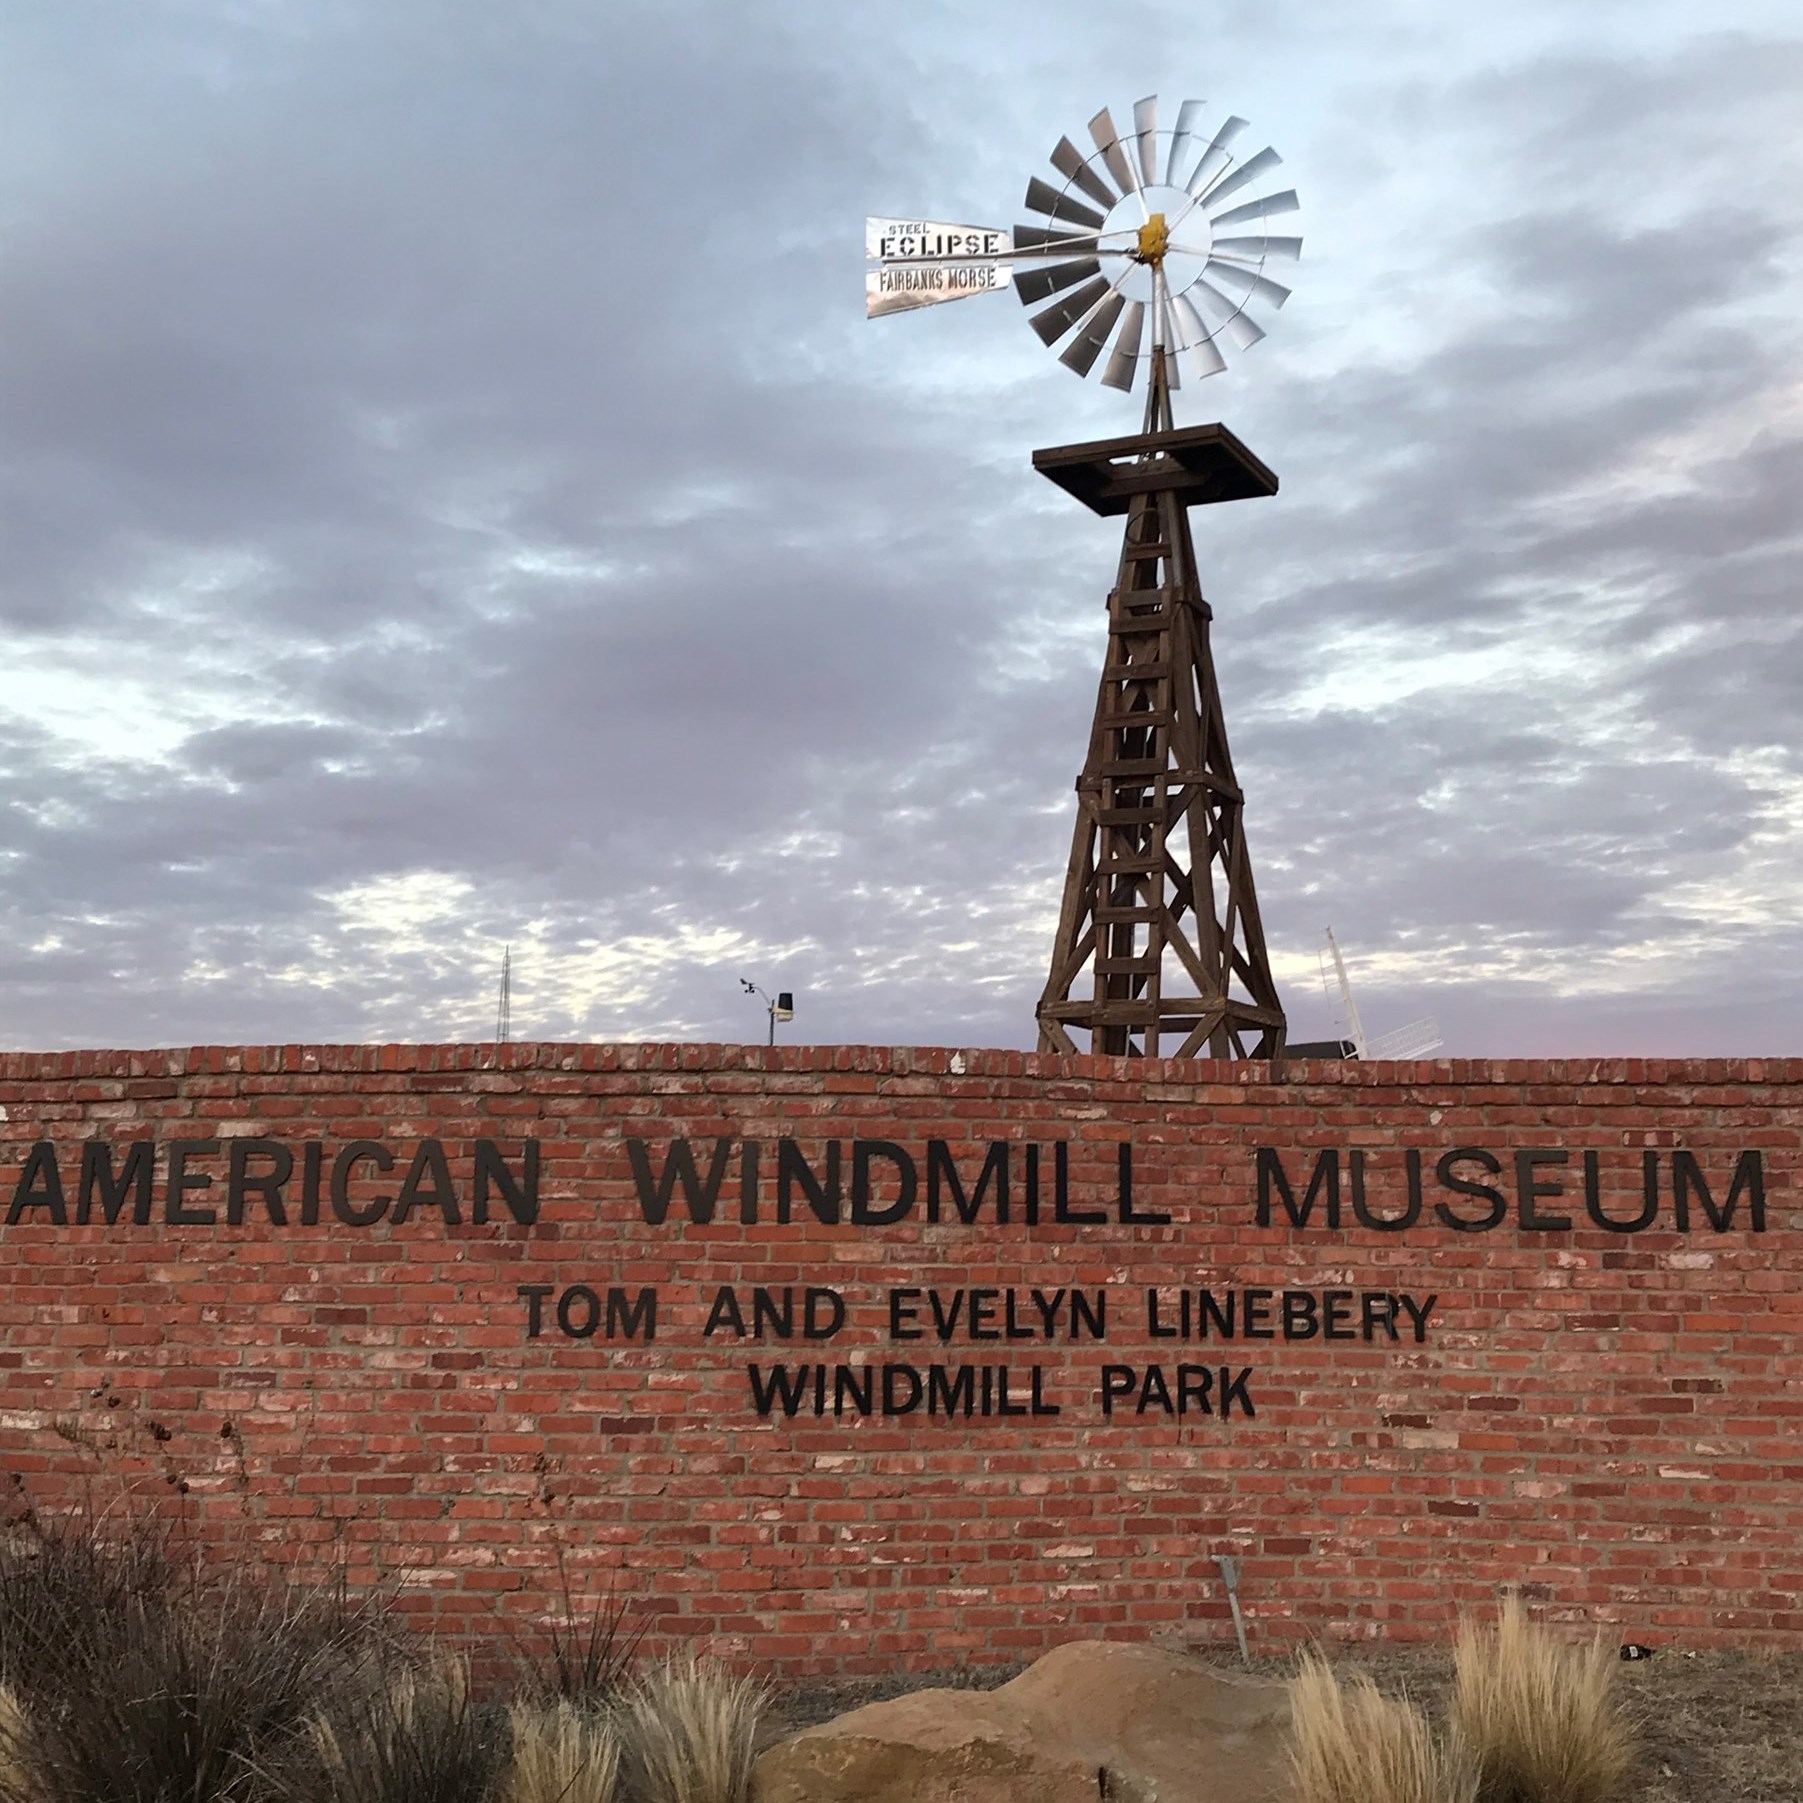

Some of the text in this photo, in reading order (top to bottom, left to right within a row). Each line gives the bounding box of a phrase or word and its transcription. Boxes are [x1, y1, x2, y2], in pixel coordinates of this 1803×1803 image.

[880, 233, 999, 257] ECLIPSE
[889, 222, 930, 236] STEEL
[880, 267, 996, 292] FAIRBANKS MORSE
[6, 1137, 1765, 1233] AMERICAN WINDMILL MUSEUM
[518, 1284, 1438, 1343] TOM AND EVELYN LINEBERY
[749, 1364, 1256, 1417] WINDMILL PARK
